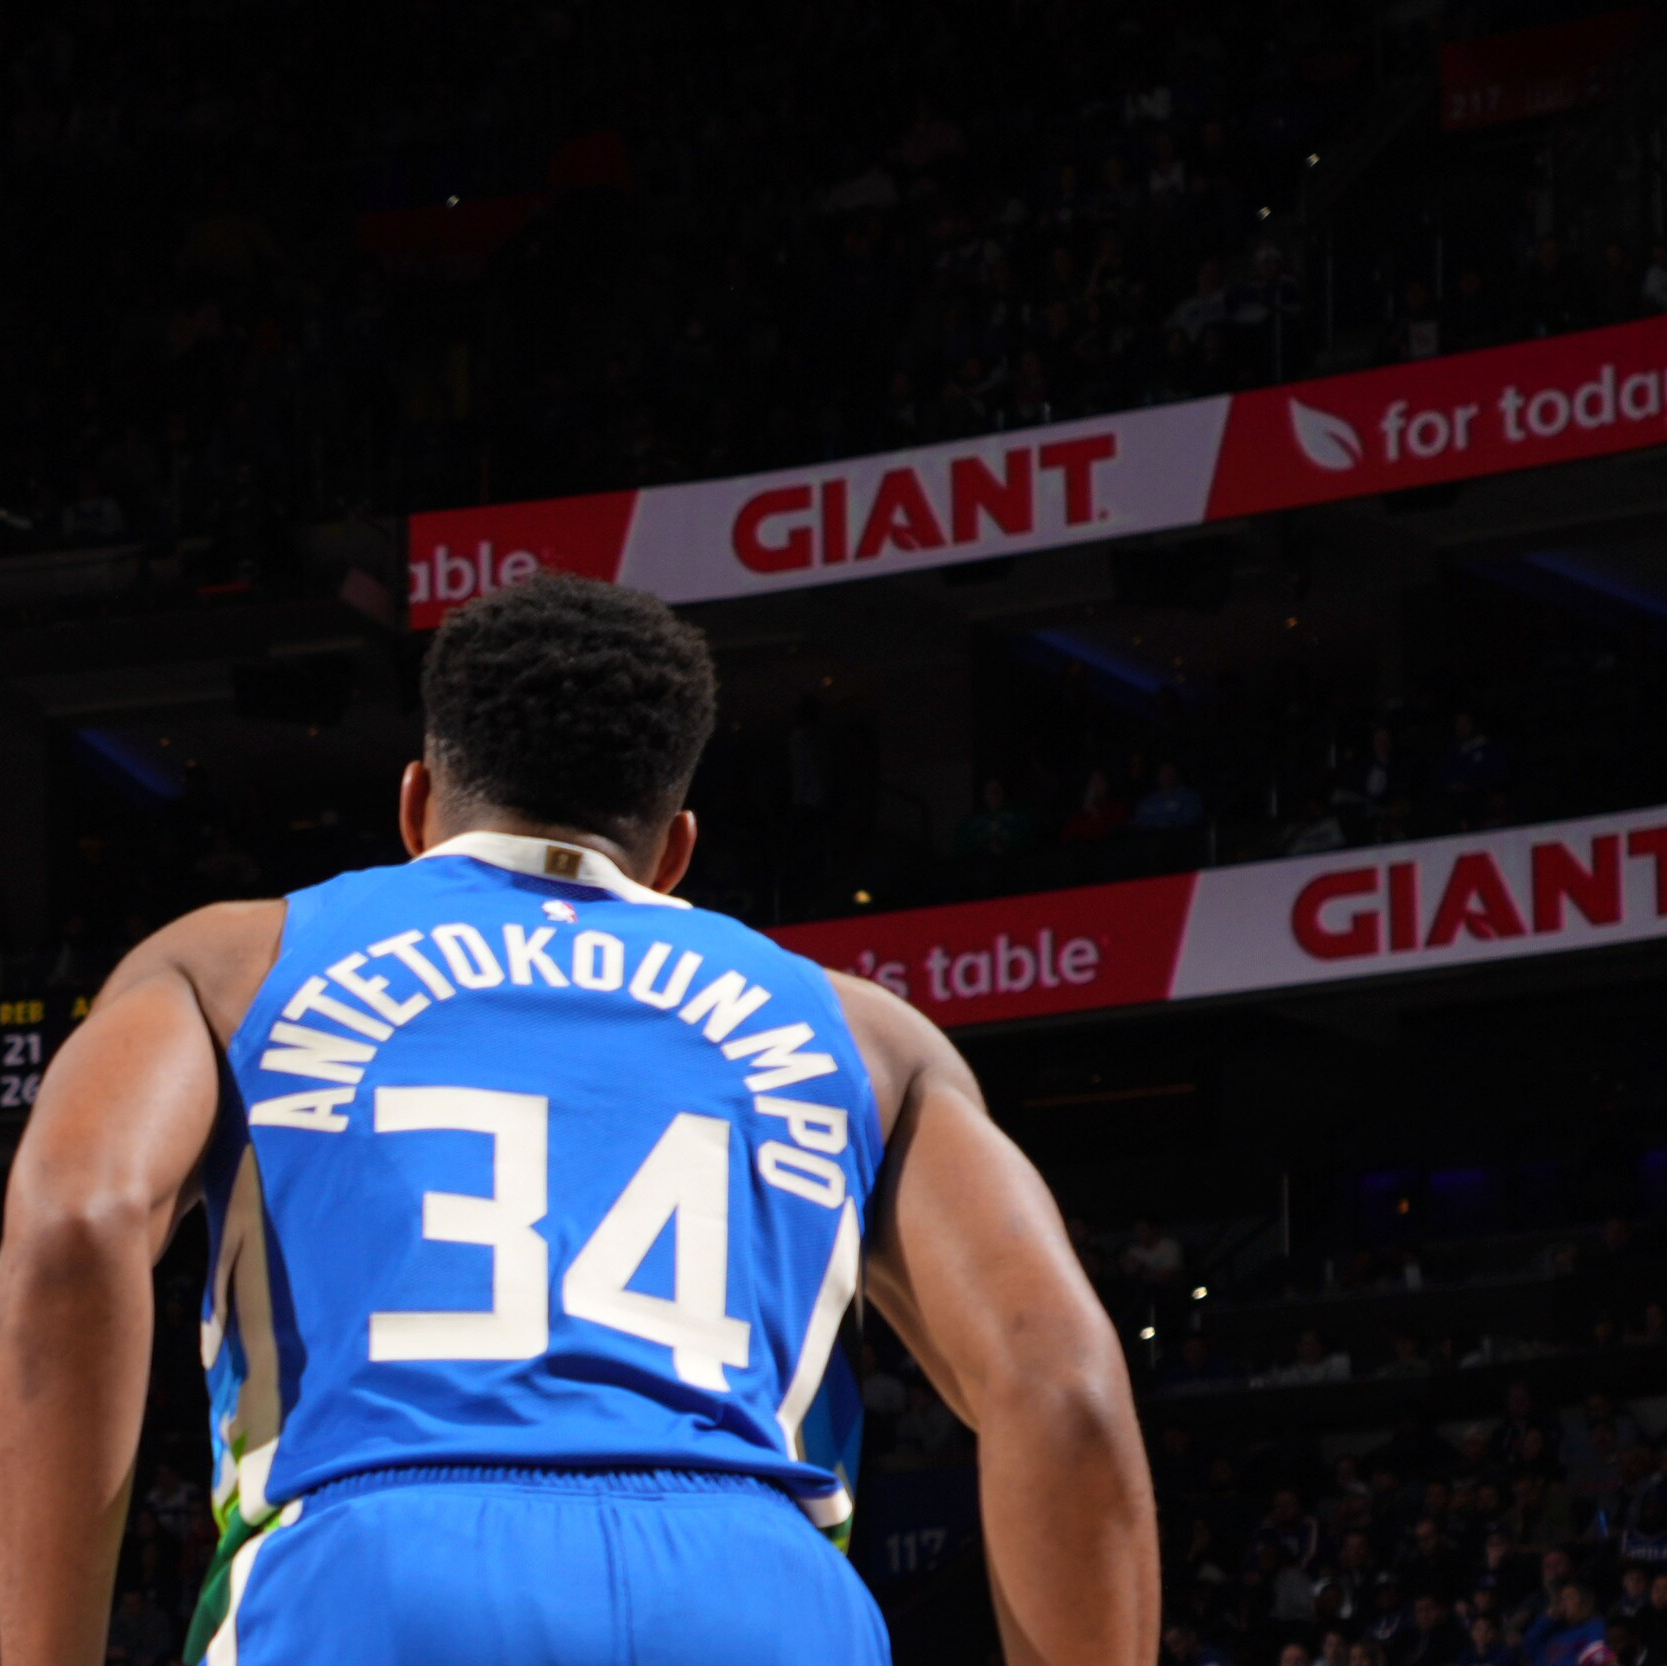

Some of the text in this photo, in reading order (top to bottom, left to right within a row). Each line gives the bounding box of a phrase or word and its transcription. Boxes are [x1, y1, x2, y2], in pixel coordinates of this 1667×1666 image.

[1380, 361, 1667, 463] for toda
[730, 433, 1117, 574] GIANT
[924, 927, 1101, 1002] table
[0, 1031, 43, 1068] 21
[247, 922, 848, 1210] ANTETOKOUNMPO
[368, 1085, 751, 1393] 34
